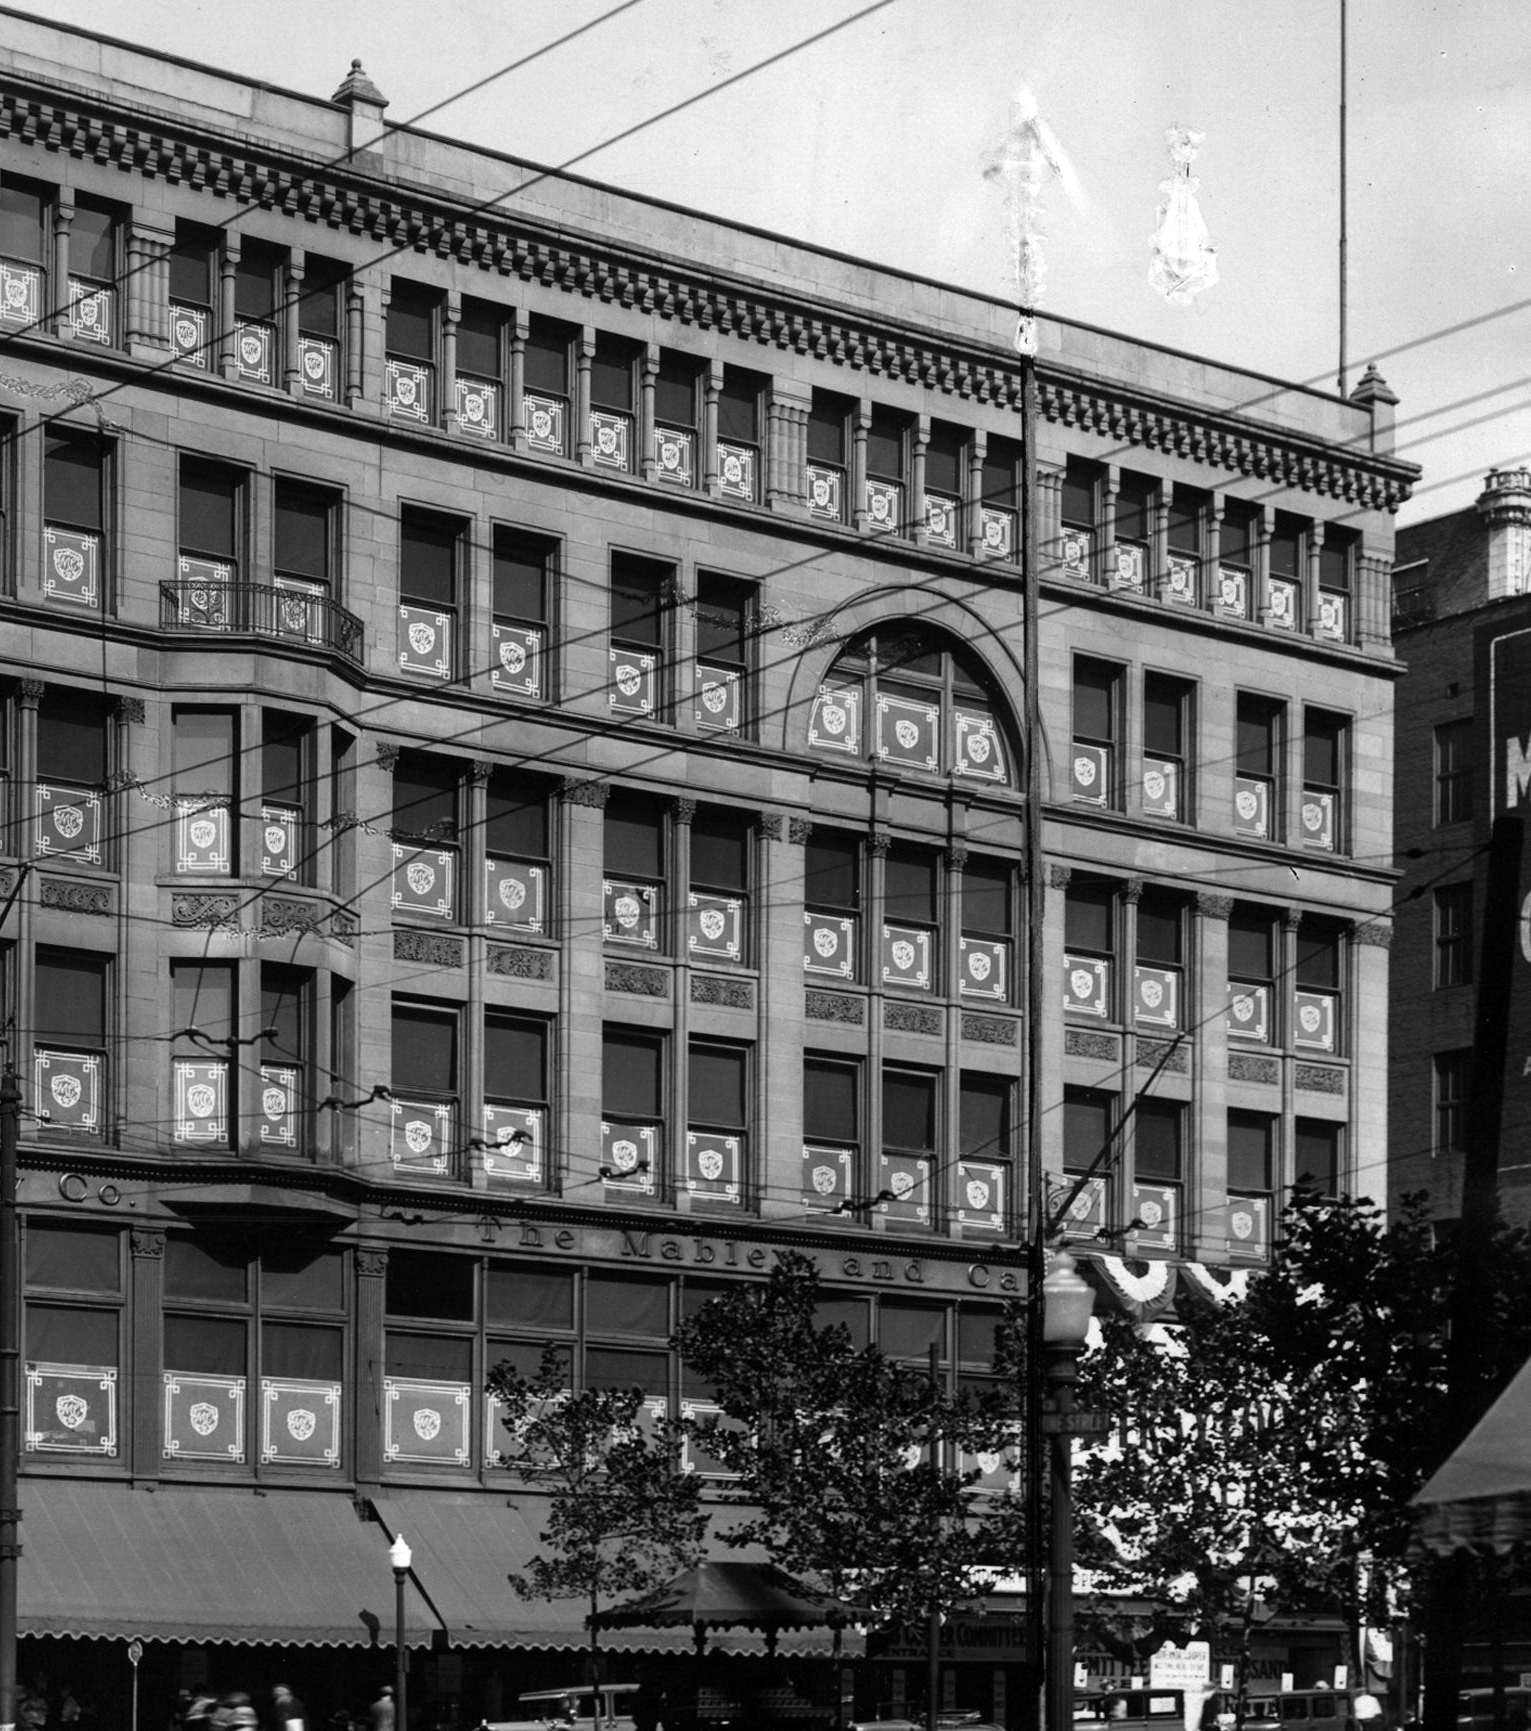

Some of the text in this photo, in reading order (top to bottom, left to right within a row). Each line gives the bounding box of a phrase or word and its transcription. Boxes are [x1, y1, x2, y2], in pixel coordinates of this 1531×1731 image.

[58, 1172, 136, 1207] Co.
[477, 1214, 575, 1250] The
[842, 1256, 924, 1283] and
